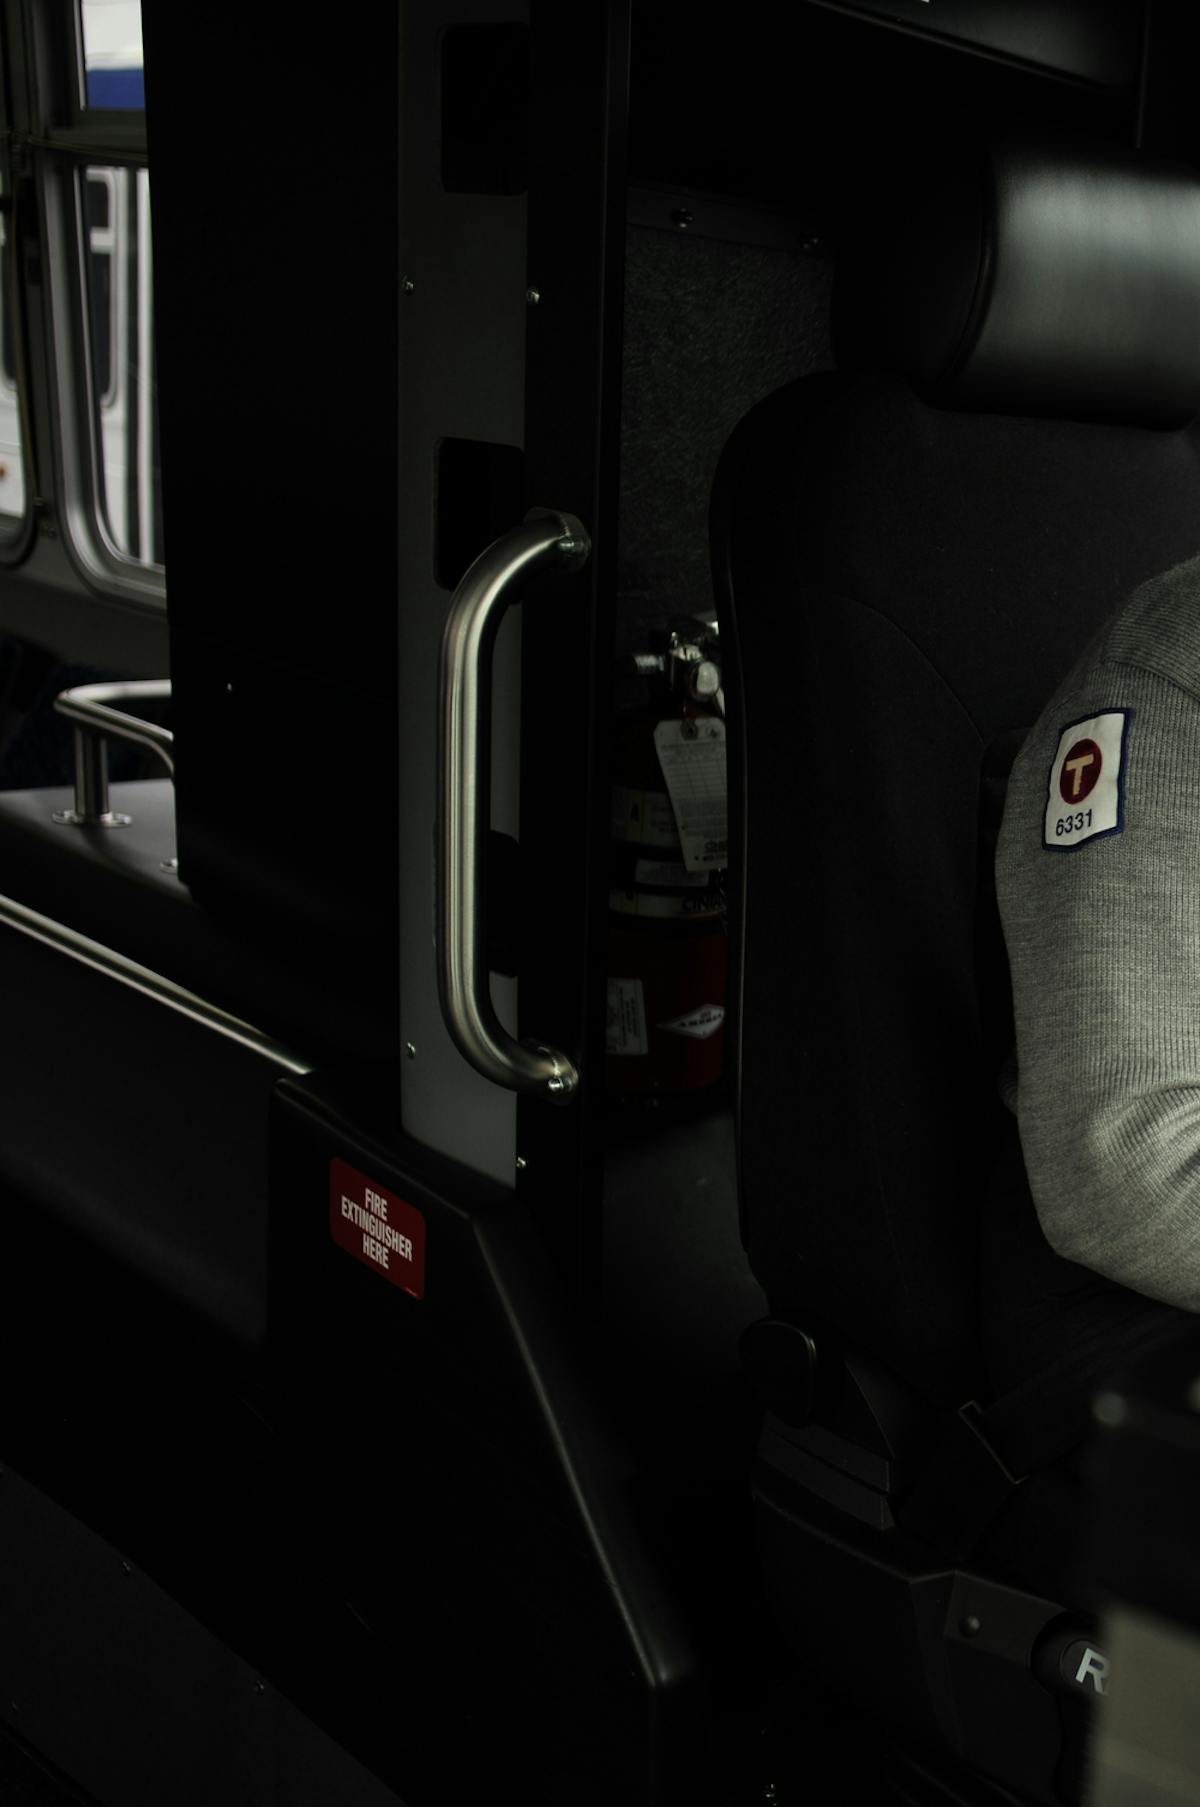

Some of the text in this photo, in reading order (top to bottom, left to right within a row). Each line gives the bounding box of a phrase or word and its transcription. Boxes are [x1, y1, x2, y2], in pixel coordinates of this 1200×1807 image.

[1065, 752, 1095, 796] T
[1055, 808, 1093, 837] 6331
[364, 1187, 388, 1221] FIRE
[341, 1195, 413, 1262] EXTINGUISHER
[362, 1232, 390, 1270] HERE
[1075, 1647, 1110, 1697] R
